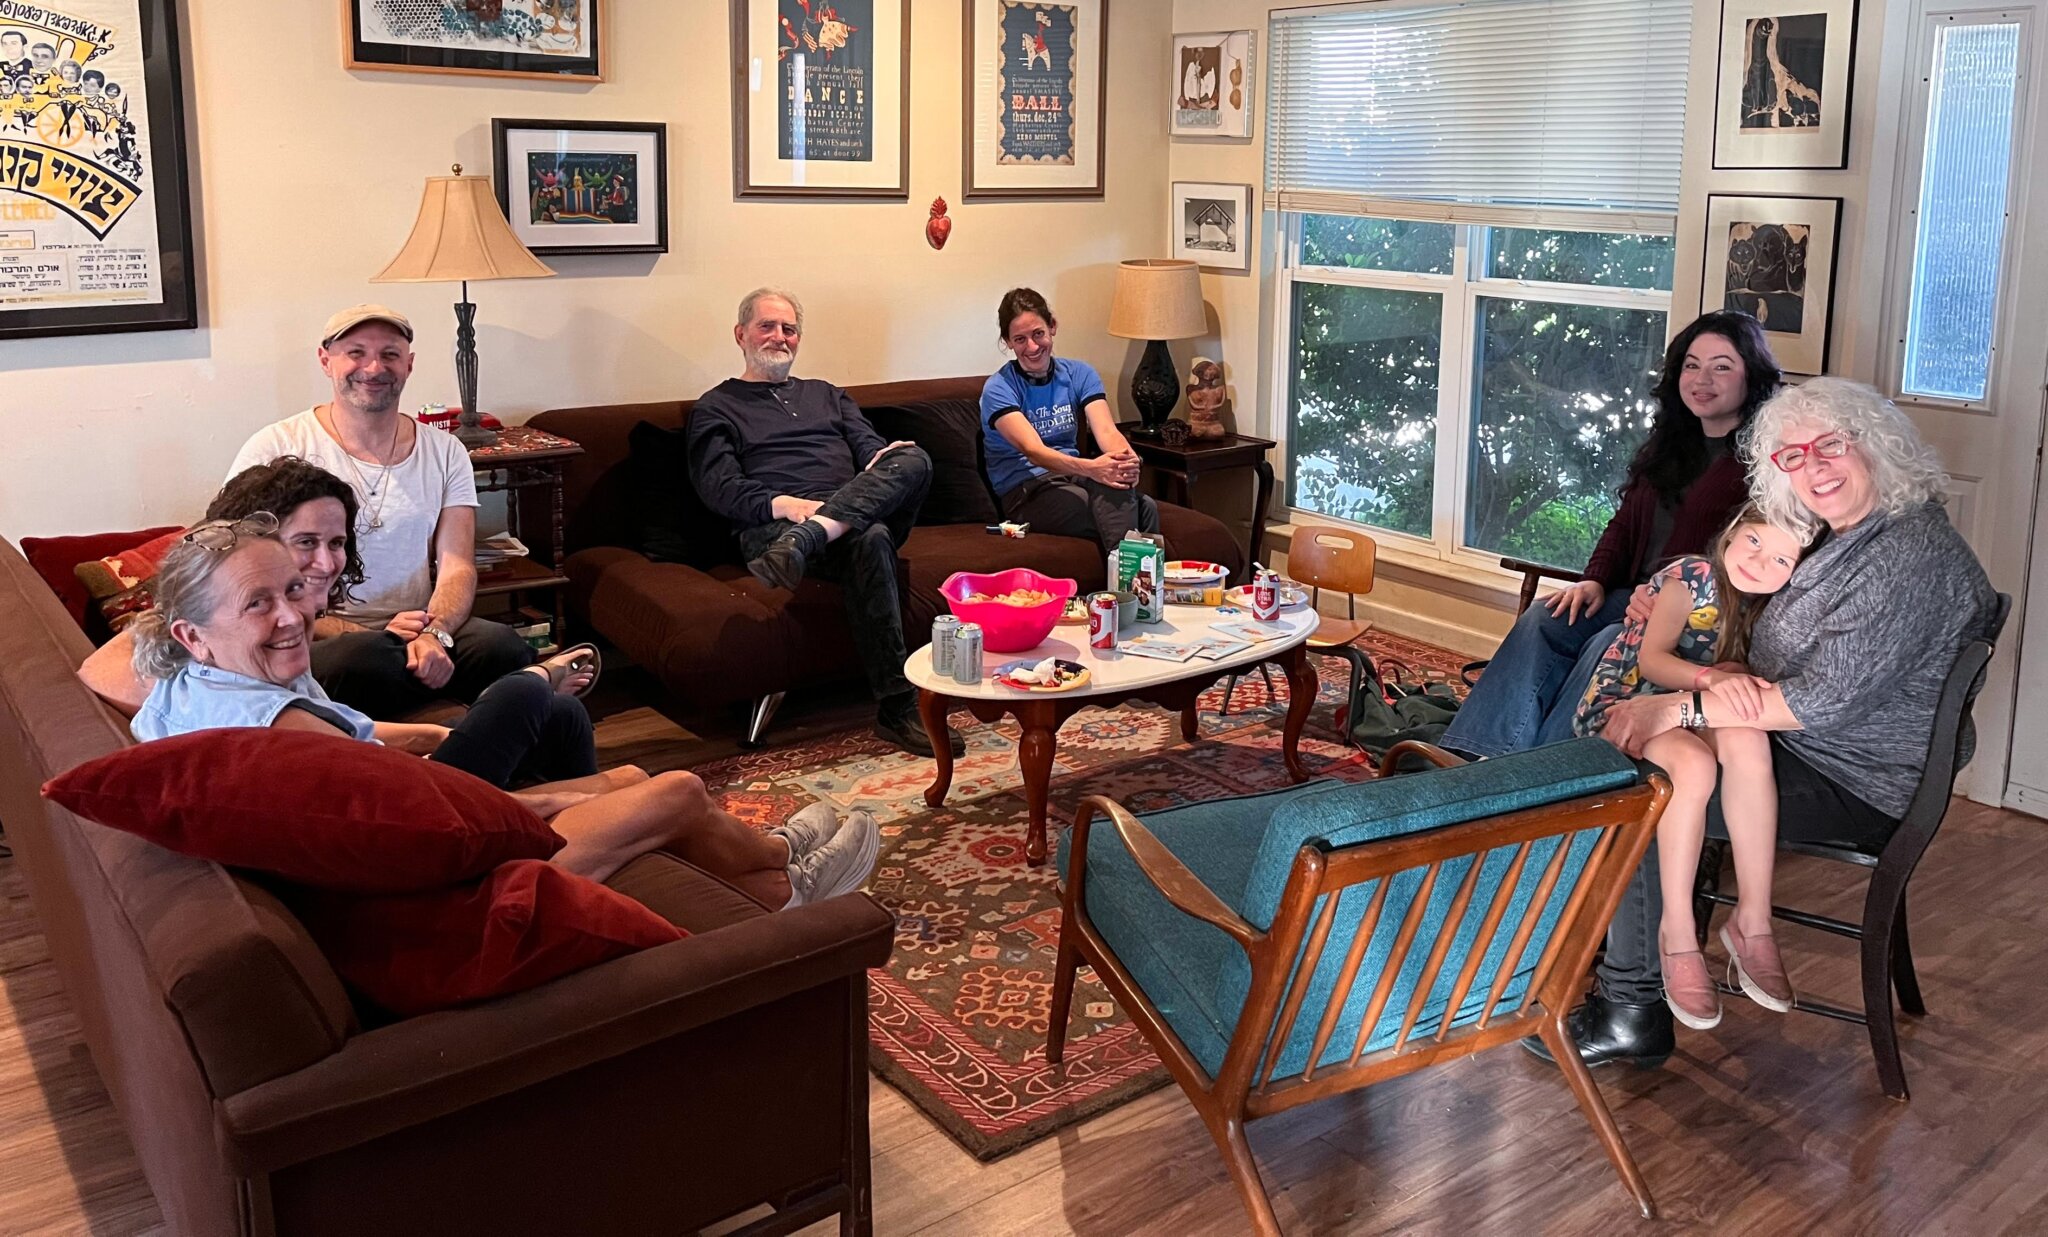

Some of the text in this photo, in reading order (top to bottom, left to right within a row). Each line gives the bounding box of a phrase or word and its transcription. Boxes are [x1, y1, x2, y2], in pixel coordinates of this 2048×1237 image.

[788, 86, 864, 104] DANCE
[1012, 94, 1062, 110] BALL
[0, 145, 44, 192] קו
[1036, 406, 1051, 418] The
